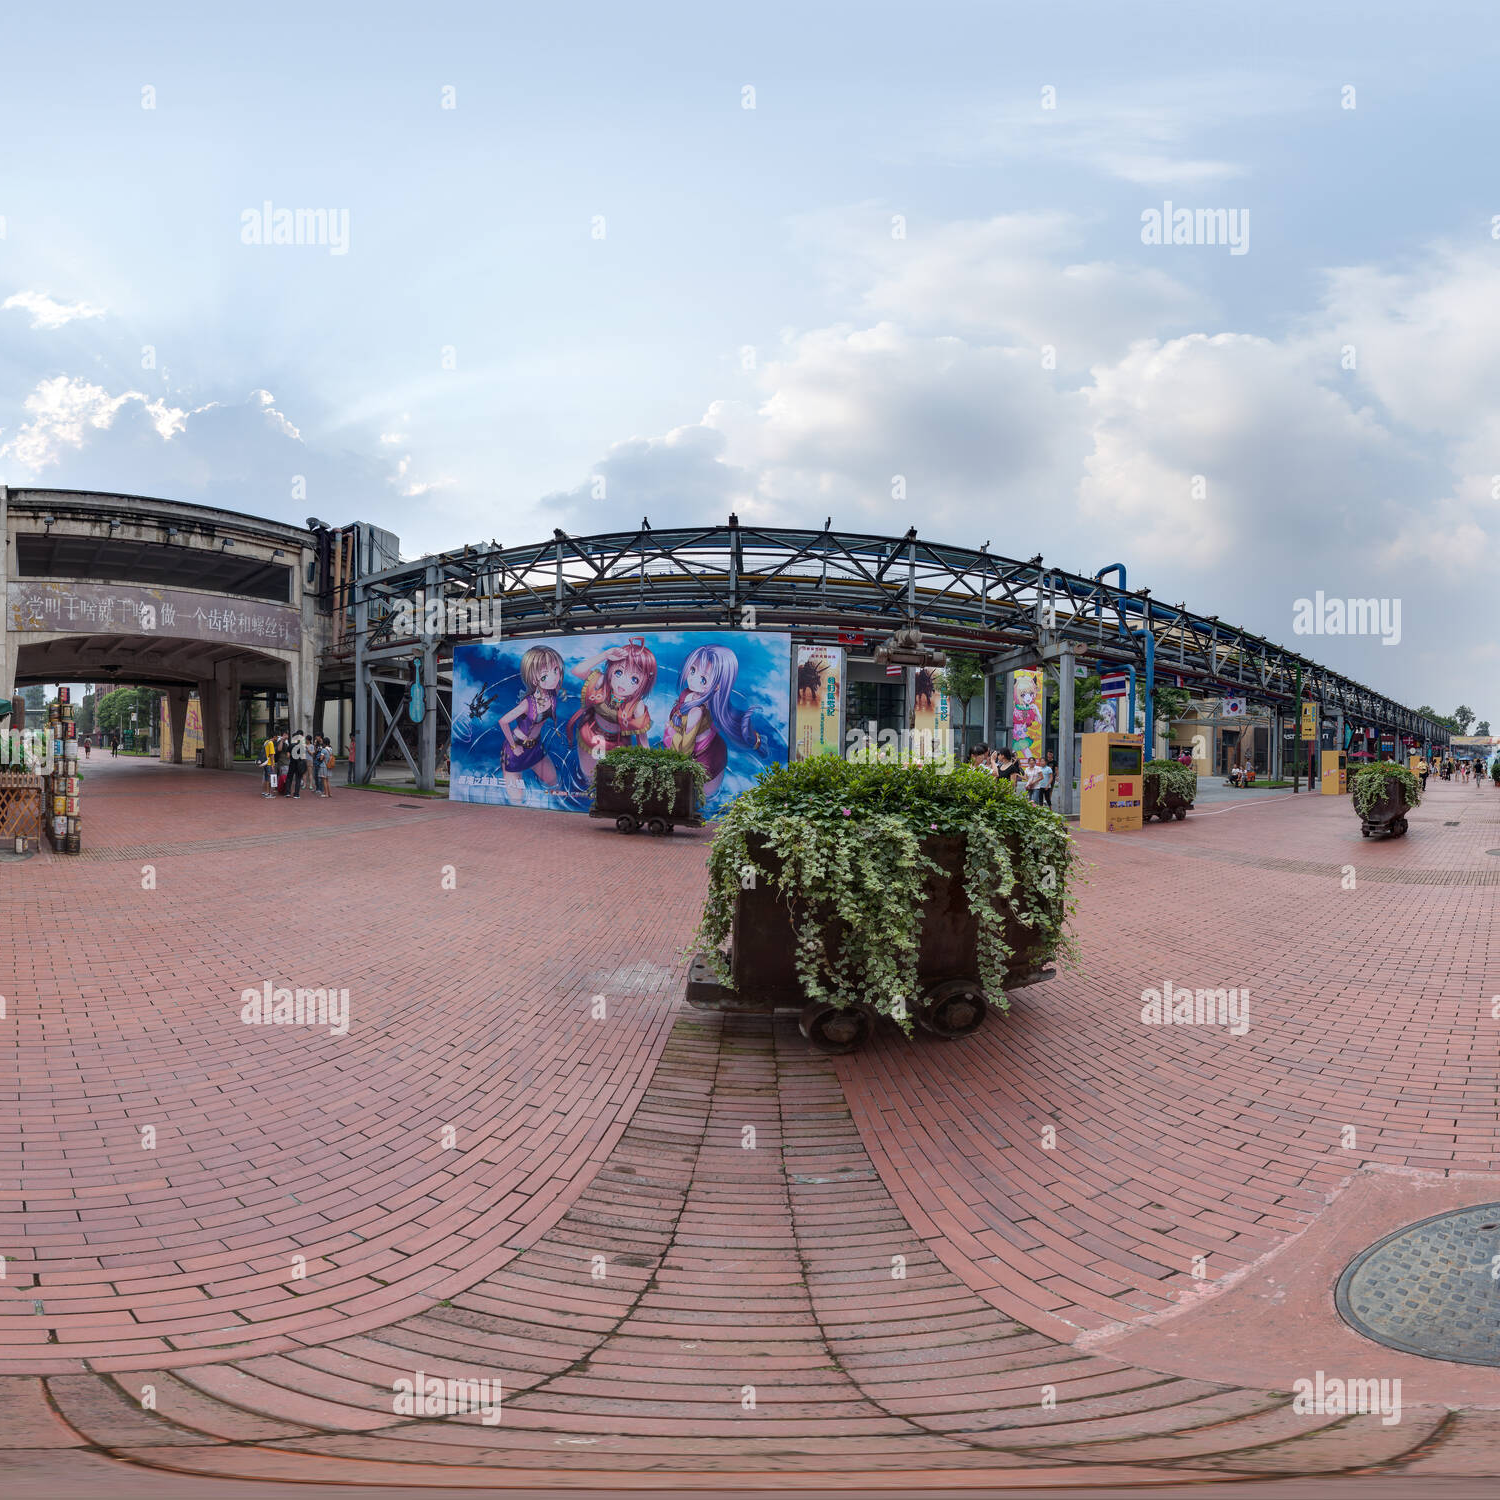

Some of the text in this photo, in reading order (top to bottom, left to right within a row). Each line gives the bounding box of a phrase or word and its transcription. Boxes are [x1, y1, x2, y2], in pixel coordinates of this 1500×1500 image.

[160, 601, 290, 642] 做一个齿轮和螺丝钉
